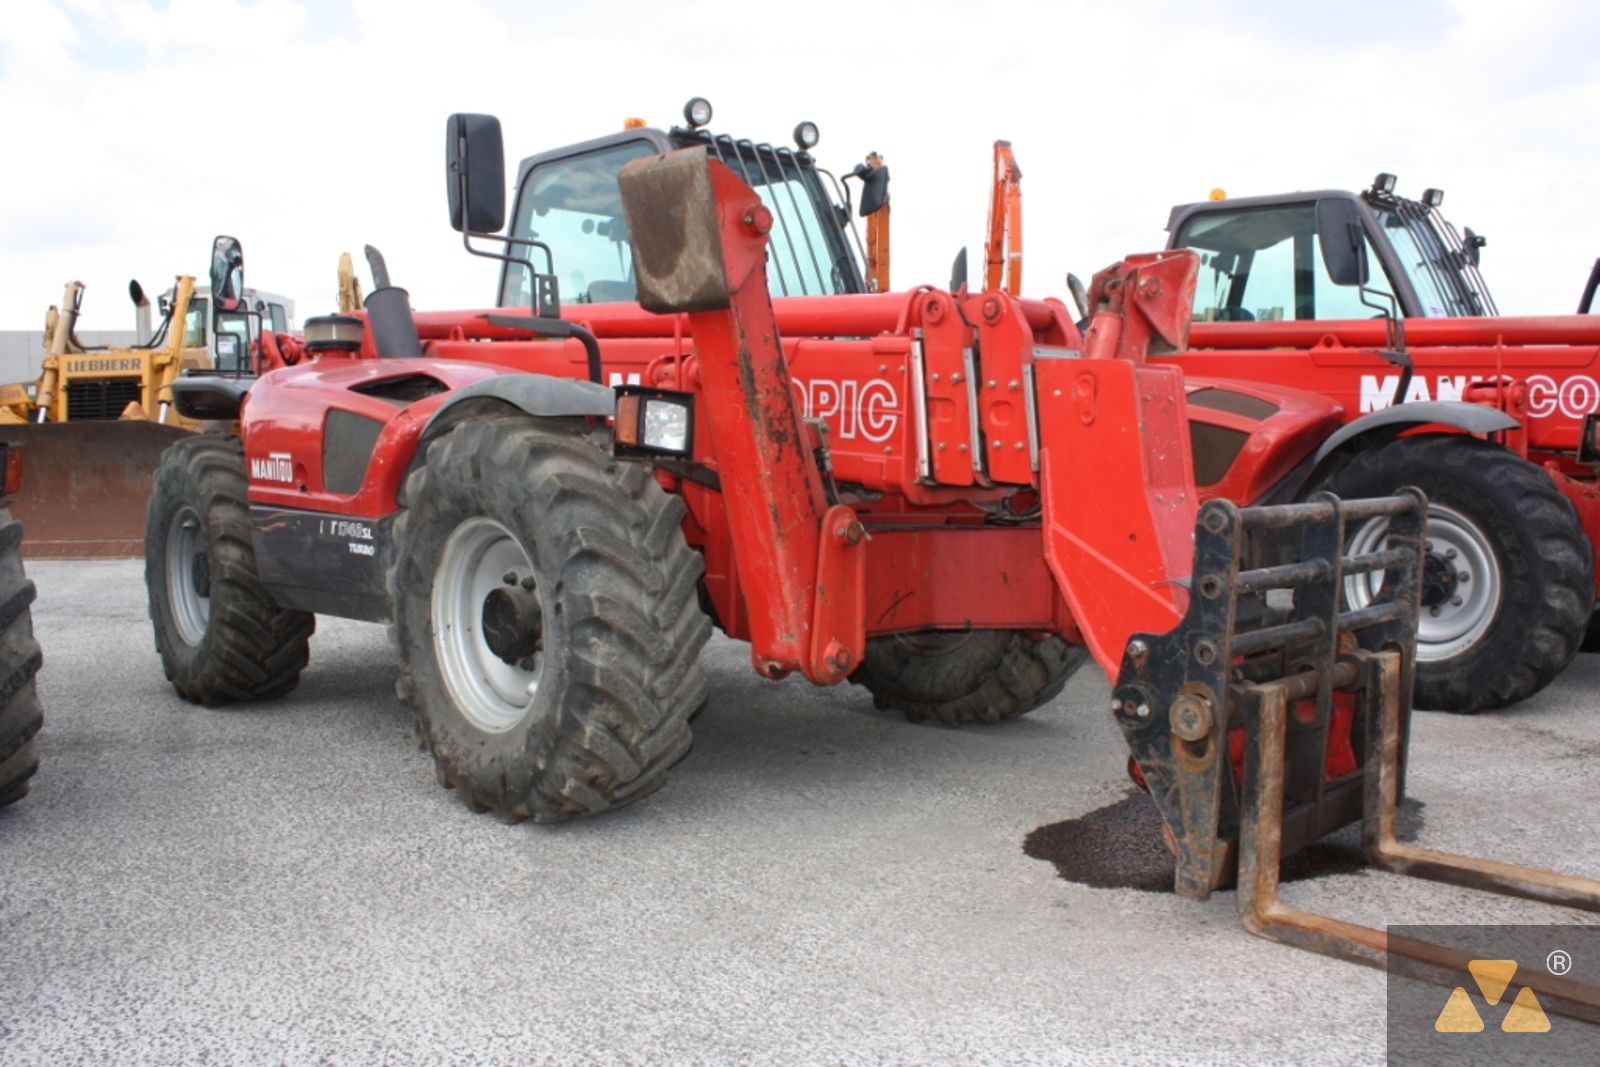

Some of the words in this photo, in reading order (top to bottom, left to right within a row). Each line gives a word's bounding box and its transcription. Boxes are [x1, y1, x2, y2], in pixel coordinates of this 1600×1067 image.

[66, 358, 142, 372] LIEBHERR
[251, 452, 293, 482] MANITOU
[348, 542, 375, 557] TURBO
